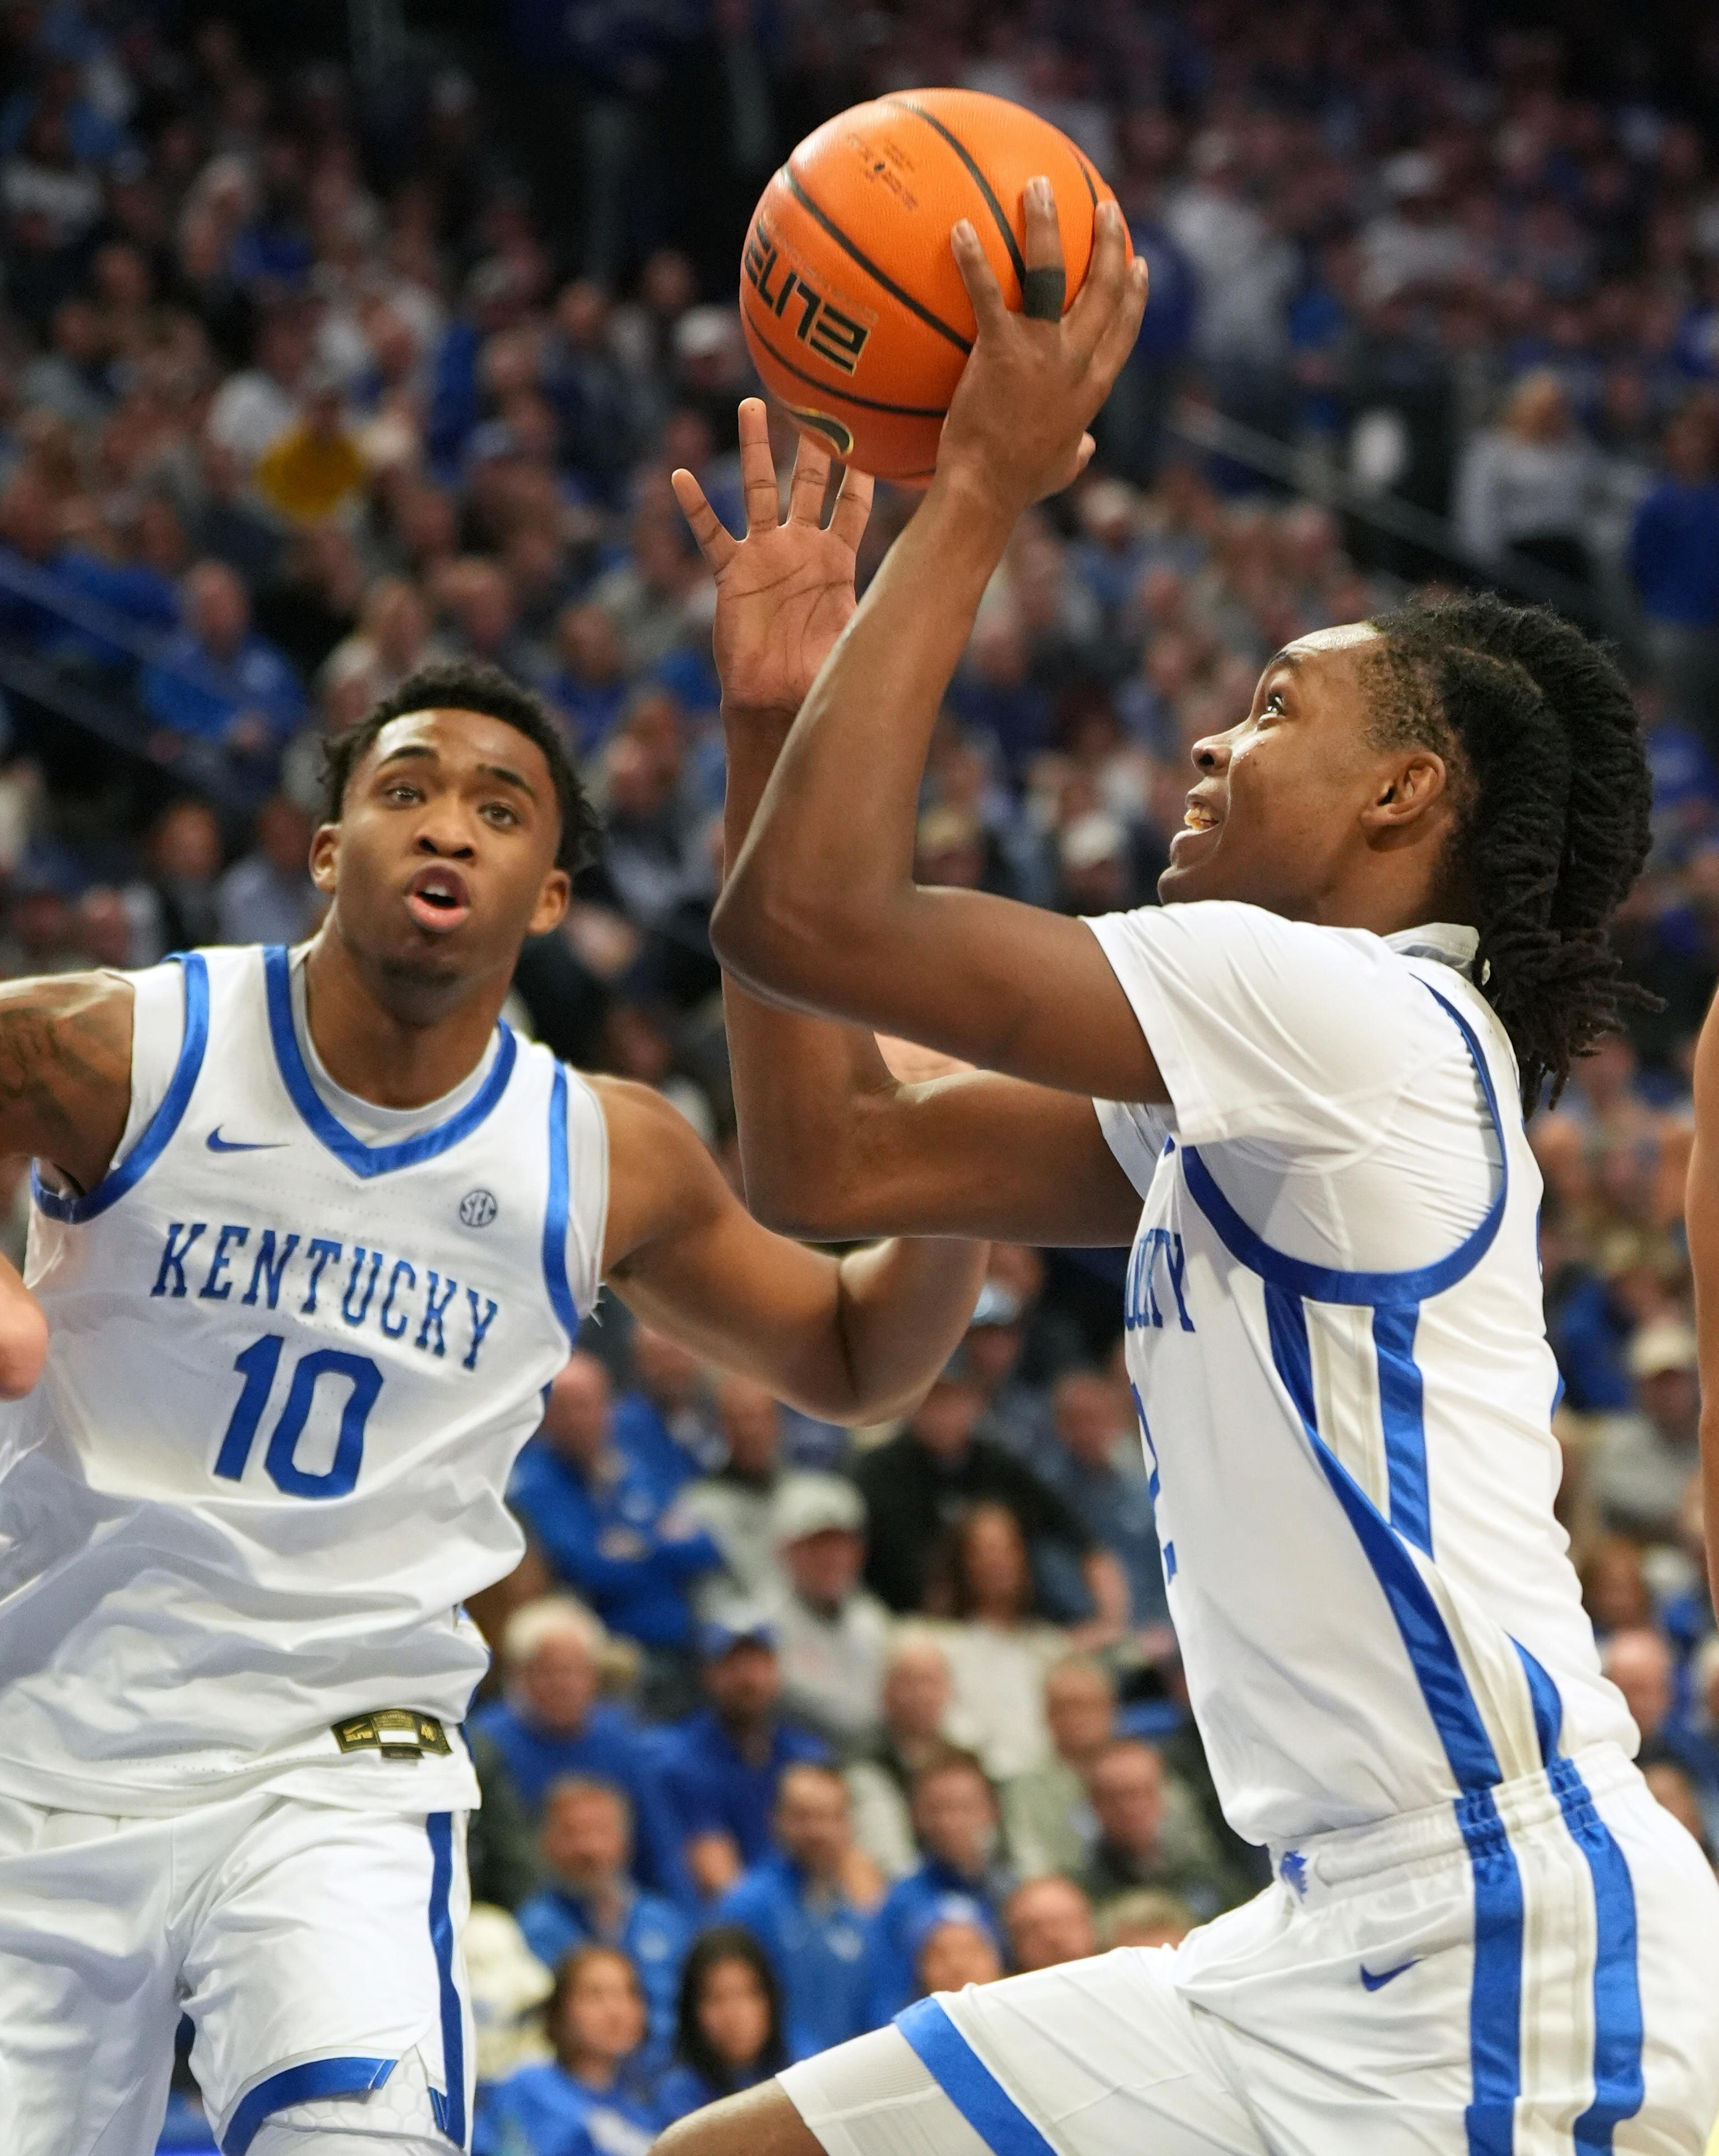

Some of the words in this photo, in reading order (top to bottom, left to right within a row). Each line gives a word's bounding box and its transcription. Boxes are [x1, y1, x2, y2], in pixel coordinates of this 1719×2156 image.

[744, 219, 870, 377] ELITE
[150, 1223, 498, 1371] KENTUCKY
[213, 1334, 384, 1498] 10
